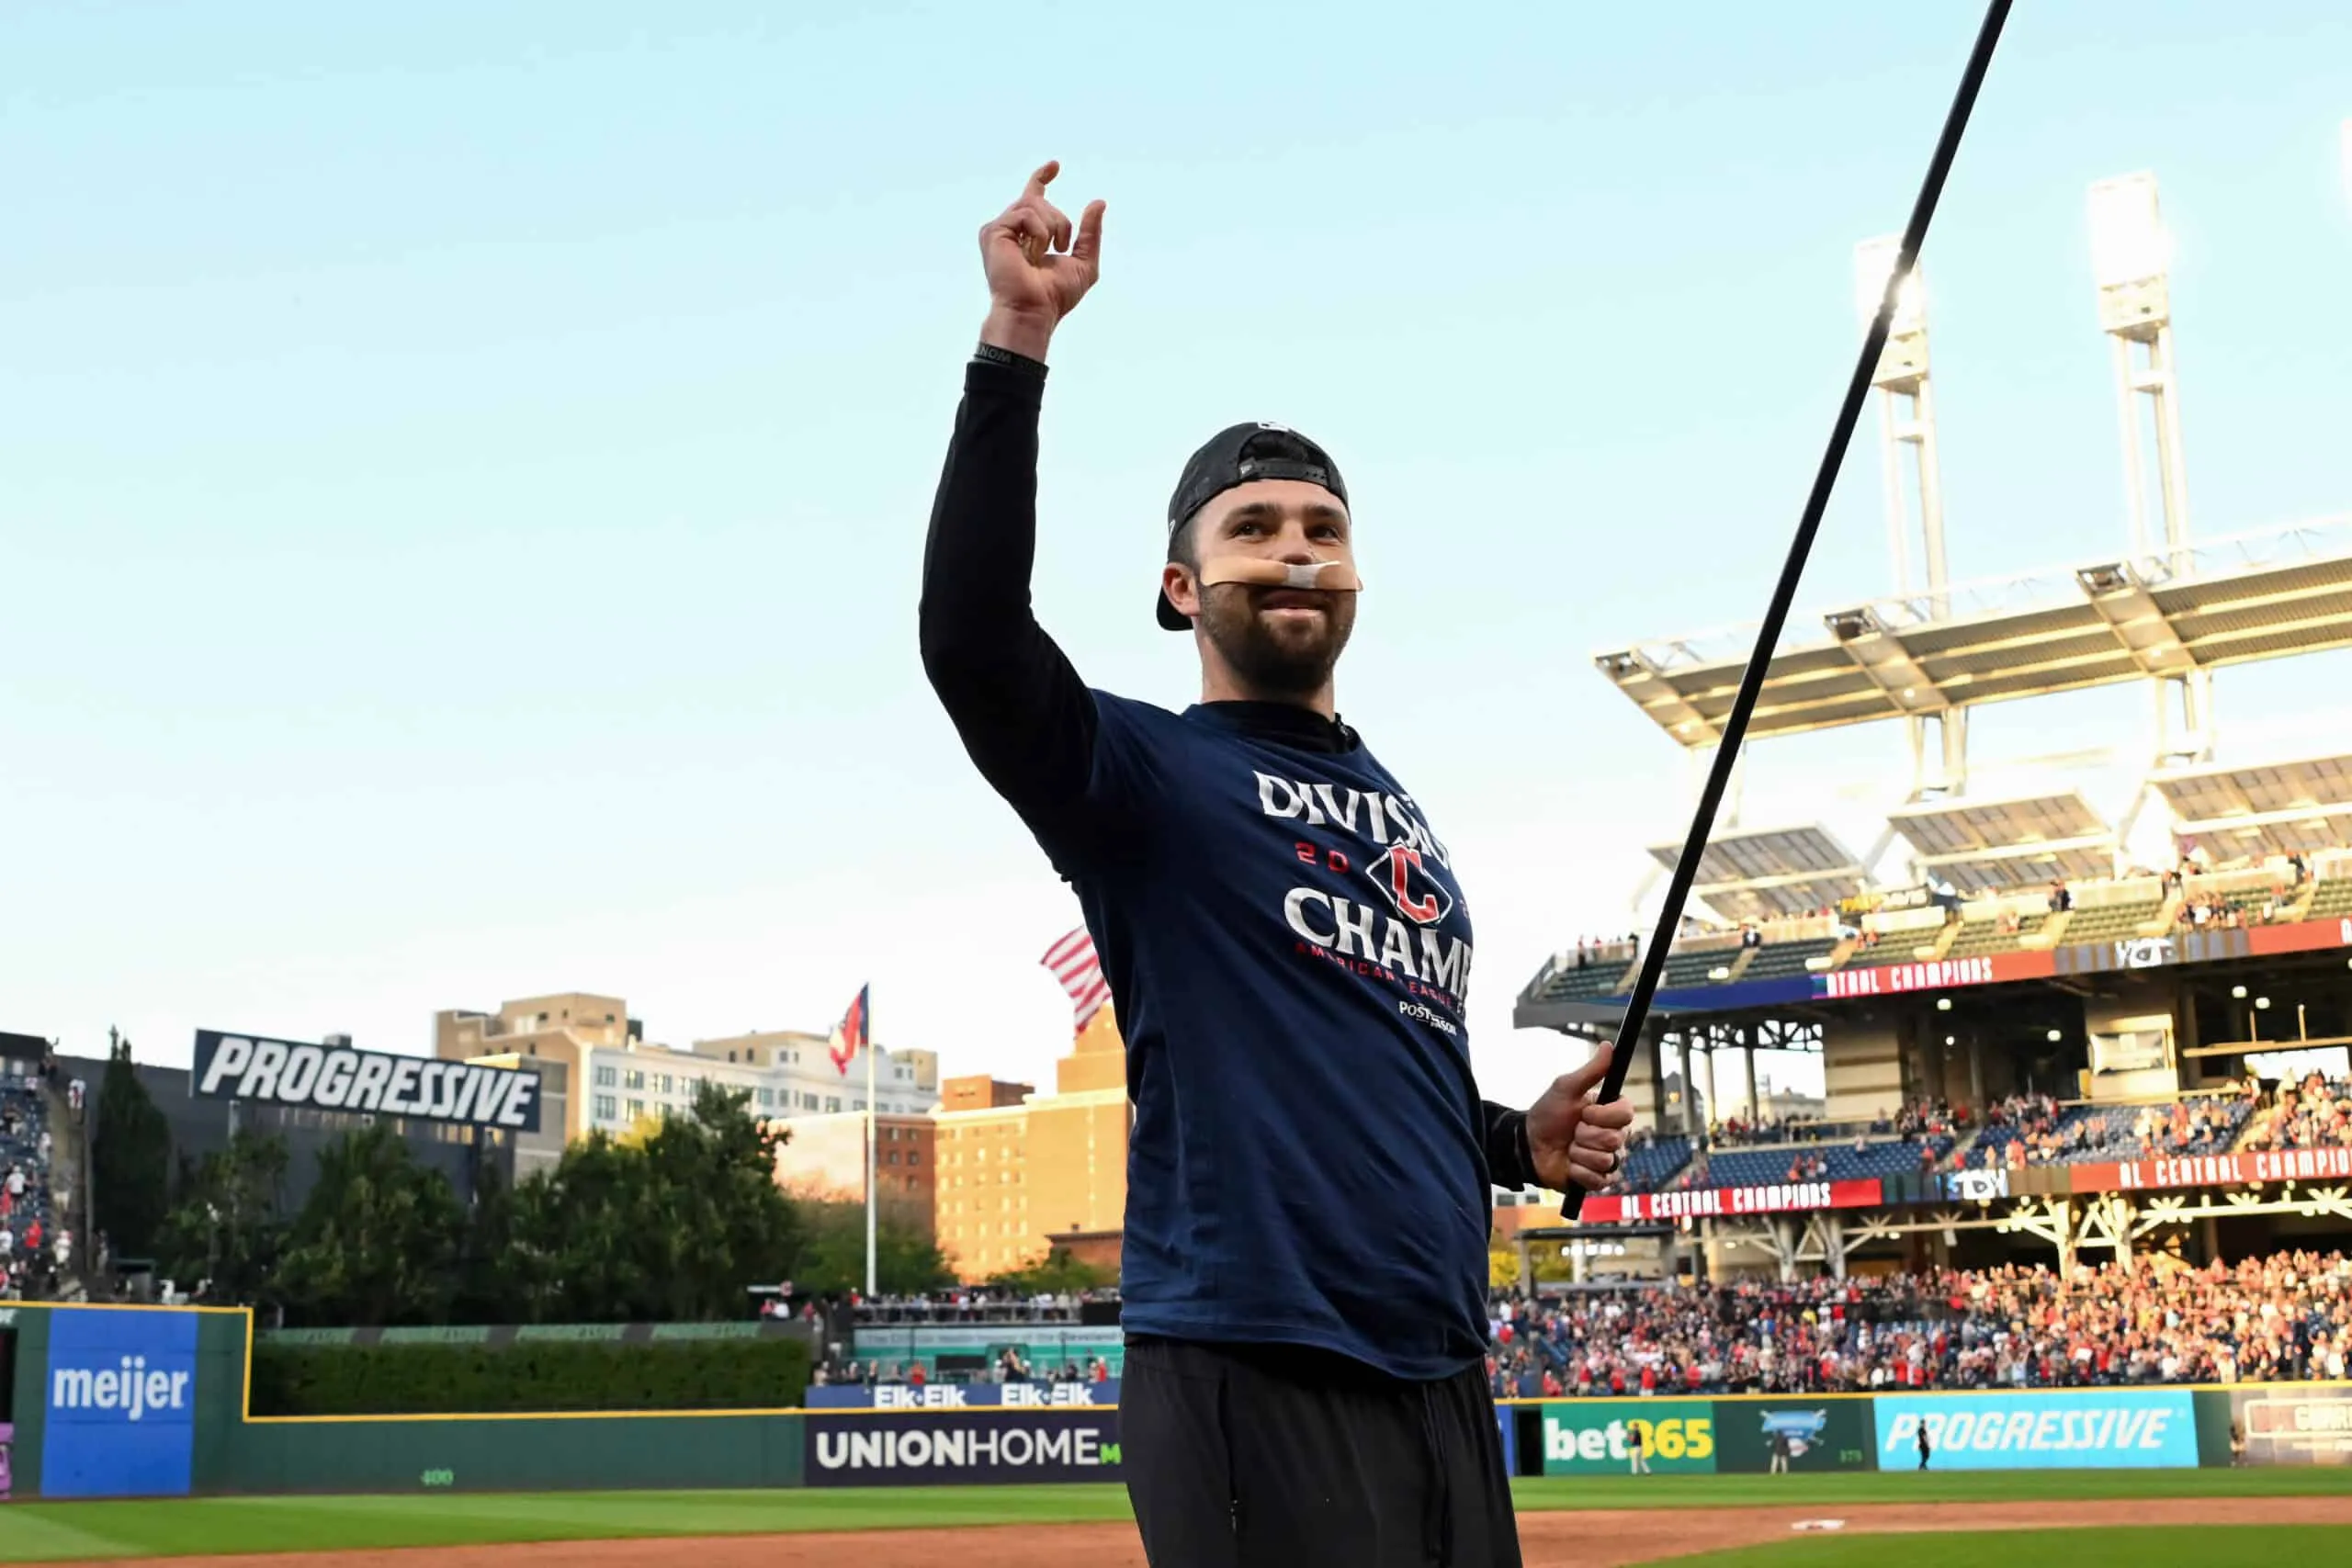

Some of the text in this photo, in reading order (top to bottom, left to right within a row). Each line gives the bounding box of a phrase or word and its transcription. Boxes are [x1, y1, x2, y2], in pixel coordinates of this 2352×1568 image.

[1396, 977, 1453, 1008] EAGUE
[1891, 956, 1993, 991] CHAMPIONS
[199, 1035, 539, 1126] PROGRESSIVE
[2155, 1156, 2243, 1187] CENTRAL
[2256, 1148, 2352, 1179] CHAMPIO
[1650, 1190, 1723, 1216] CENTRAL
[1732, 1182, 1831, 1212] CHAMPIONS
[52, 1355, 188, 1421] meijer
[1544, 1418, 1713, 1461] bet365
[1885, 1408, 2172, 1452] PROGRESSIVE
